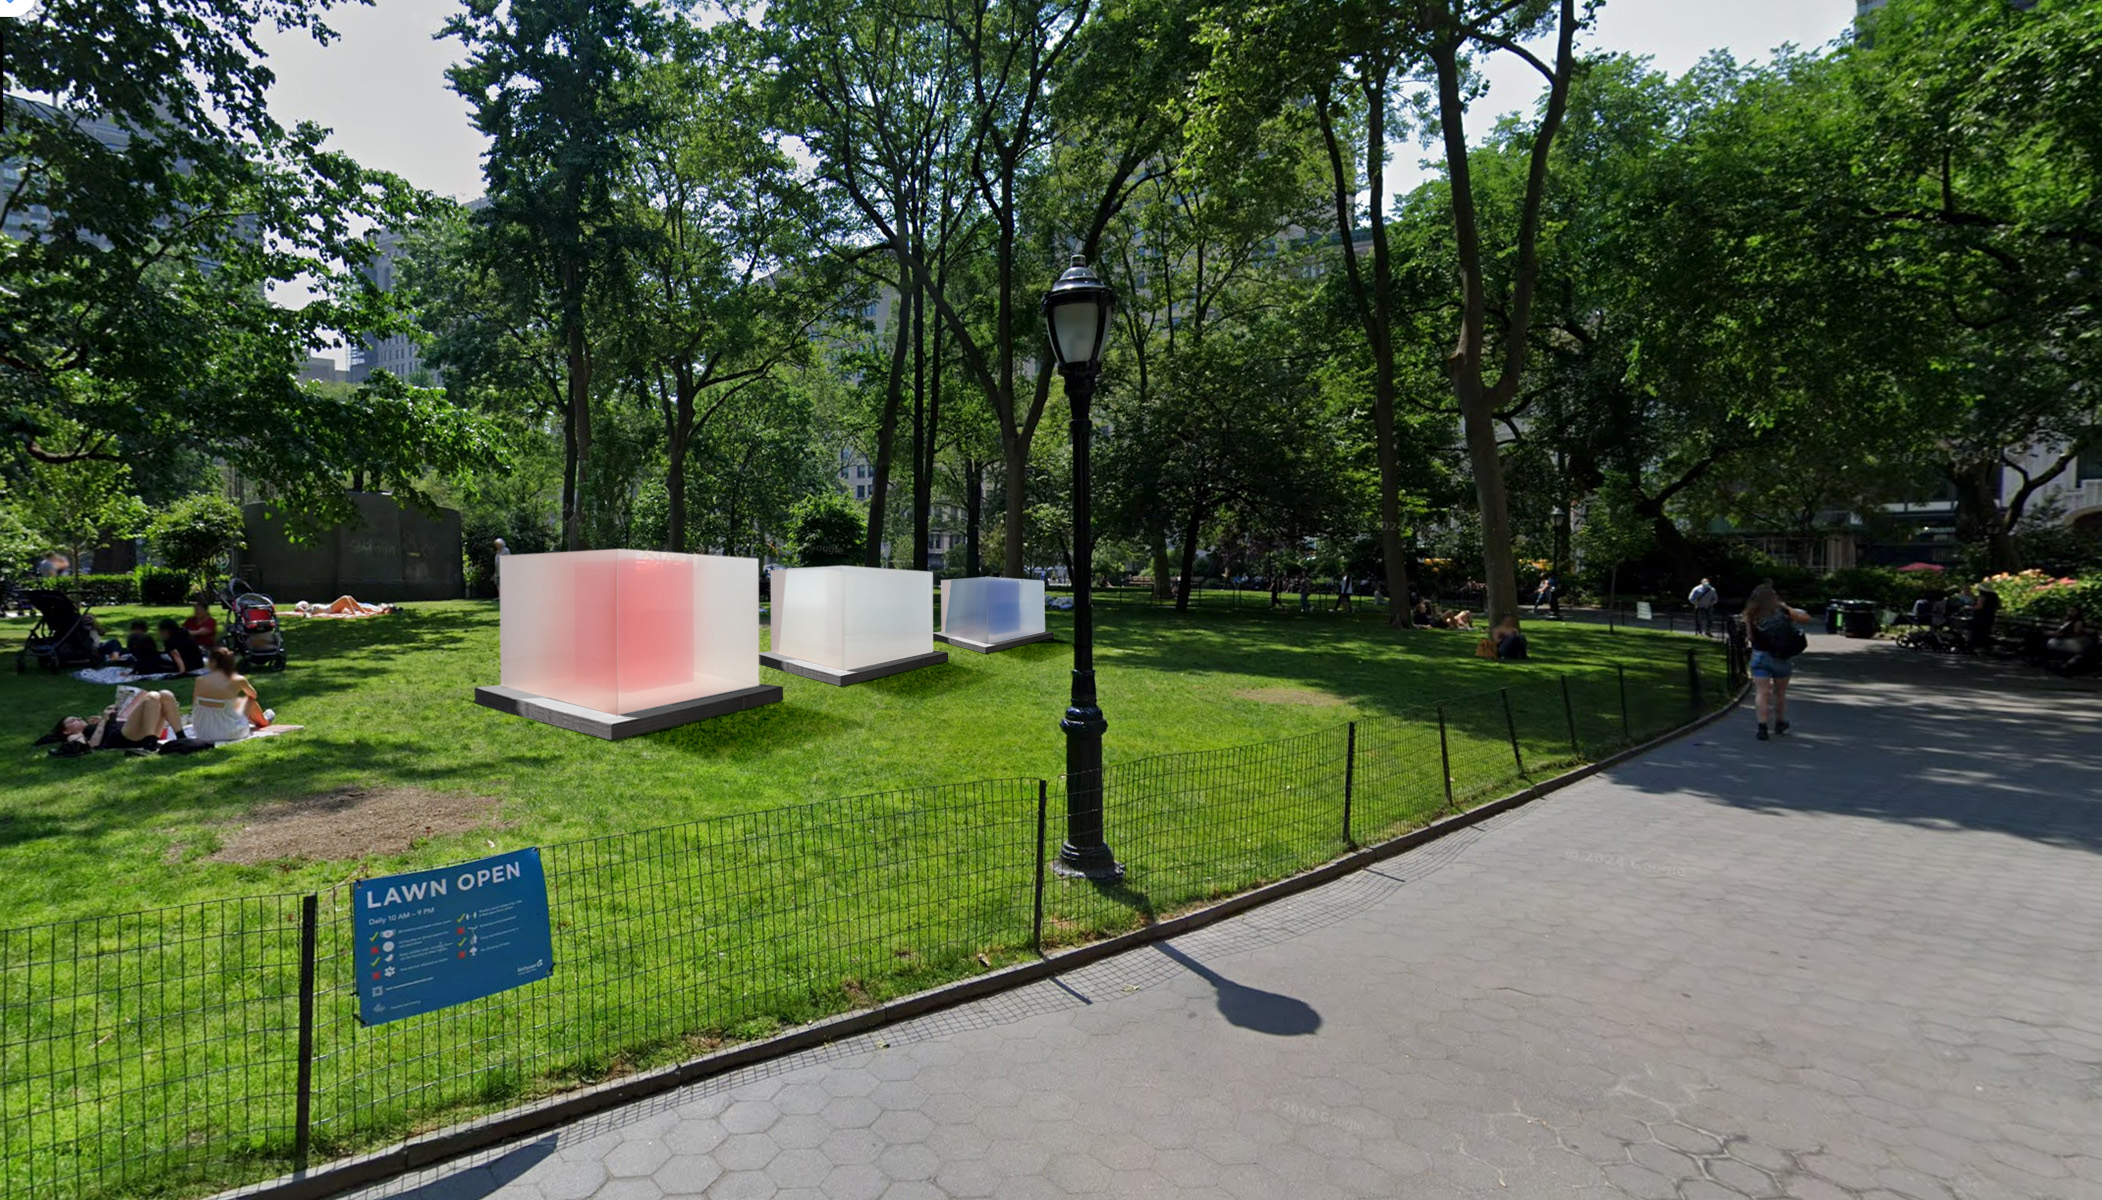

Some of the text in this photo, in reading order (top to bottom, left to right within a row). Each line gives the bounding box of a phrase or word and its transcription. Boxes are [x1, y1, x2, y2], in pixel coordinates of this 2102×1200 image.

[367, 879, 447, 909] LAWN
[457, 861, 521, 891] OPEN
[368, 917, 386, 926] Daily
[398, 912, 411, 920] AM
[423, 907, 435, 915] PM
